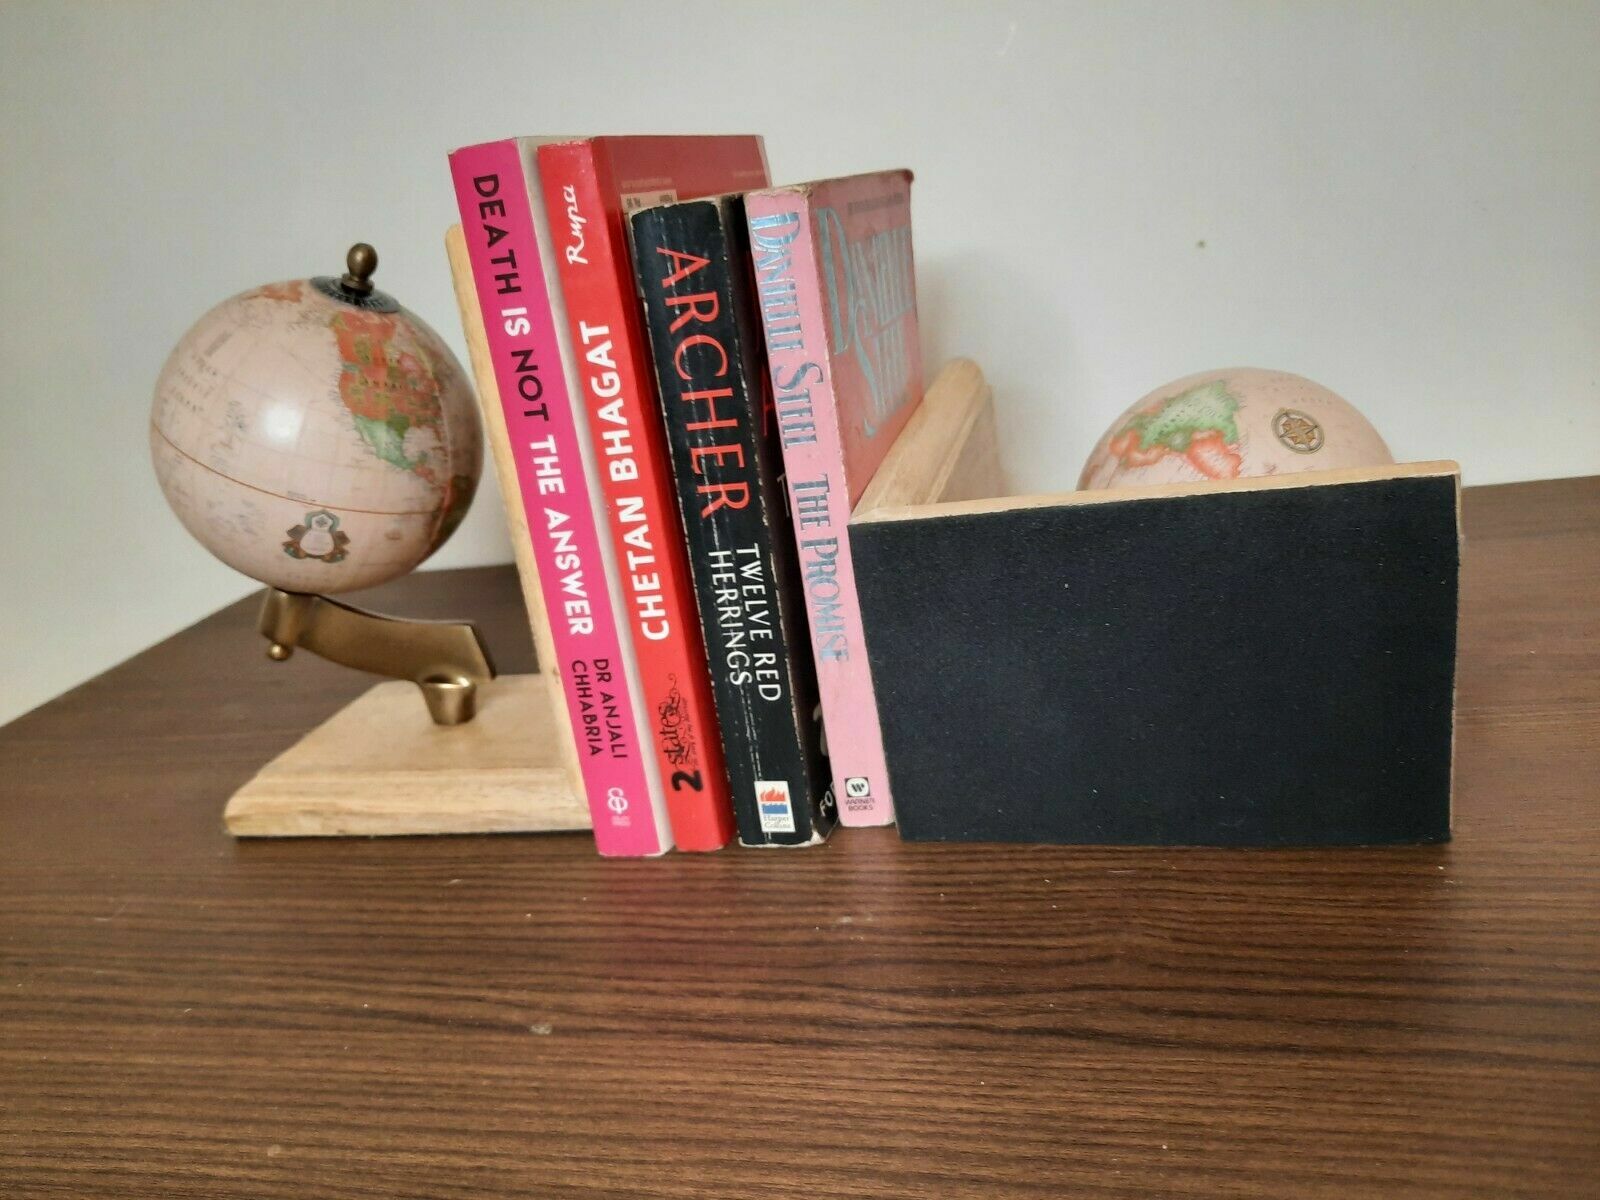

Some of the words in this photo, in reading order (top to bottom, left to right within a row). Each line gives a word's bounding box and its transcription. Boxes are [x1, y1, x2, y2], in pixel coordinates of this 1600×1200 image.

[473, 174, 521, 294] DEATH
[501, 307, 531, 336] IS
[511, 350, 549, 421] NOT
[579, 321, 638, 482] BHAGAT
[656, 247, 749, 519] ARCHER
[529, 435, 566, 496] THE
[793, 473, 832, 530] THE
[544, 507, 593, 636] ANSWER
[615, 496, 670, 640] CHETAN
[736, 543, 773, 641] TWELVE
[801, 536, 849, 664] PROMISE
[708, 550, 752, 686] HERRINGS
[571, 660, 602, 757] CHHABRIA
[593, 658, 613, 684] DR
[754, 652, 782, 701] RED
[601, 689, 628, 759] ANJALI
